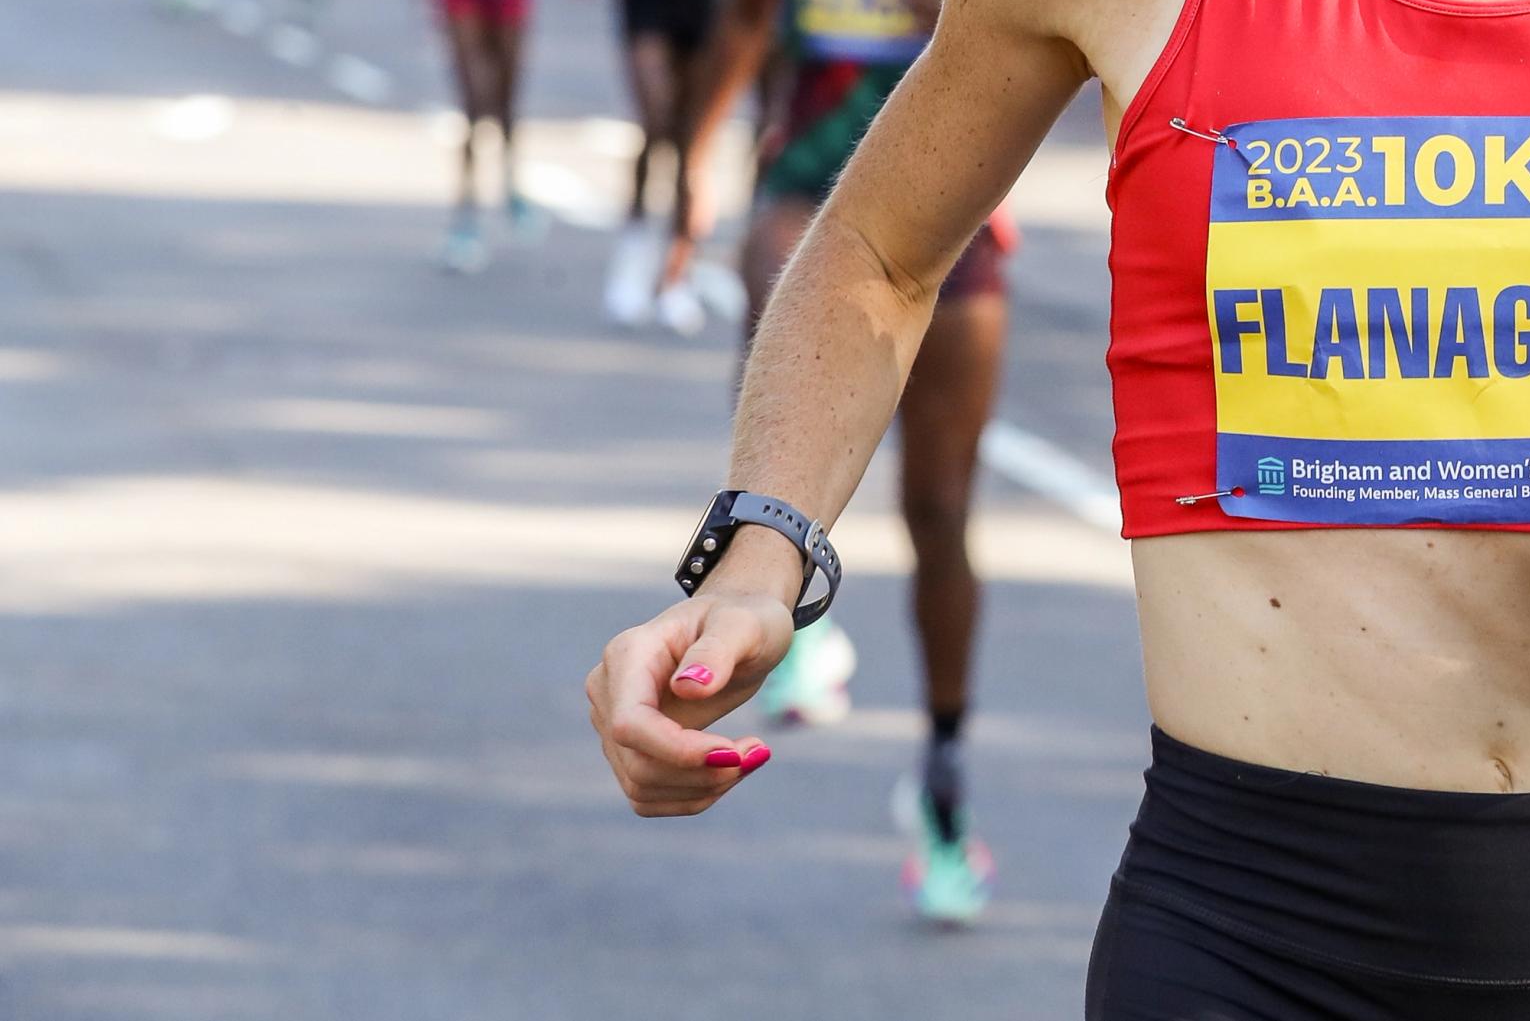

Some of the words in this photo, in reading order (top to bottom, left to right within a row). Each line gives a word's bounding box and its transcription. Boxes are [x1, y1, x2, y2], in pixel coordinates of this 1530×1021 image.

[1246, 136, 1364, 175] 2023
[1246, 177, 1378, 209] B.A.A.
[1292, 459, 1383, 484] Brigham
[1389, 460, 1431, 481] and
[1292, 484, 1356, 502] Founding
[1359, 486, 1420, 501] Member,
[1424, 487, 1460, 500] Mass
[1463, 485, 1517, 499] General
